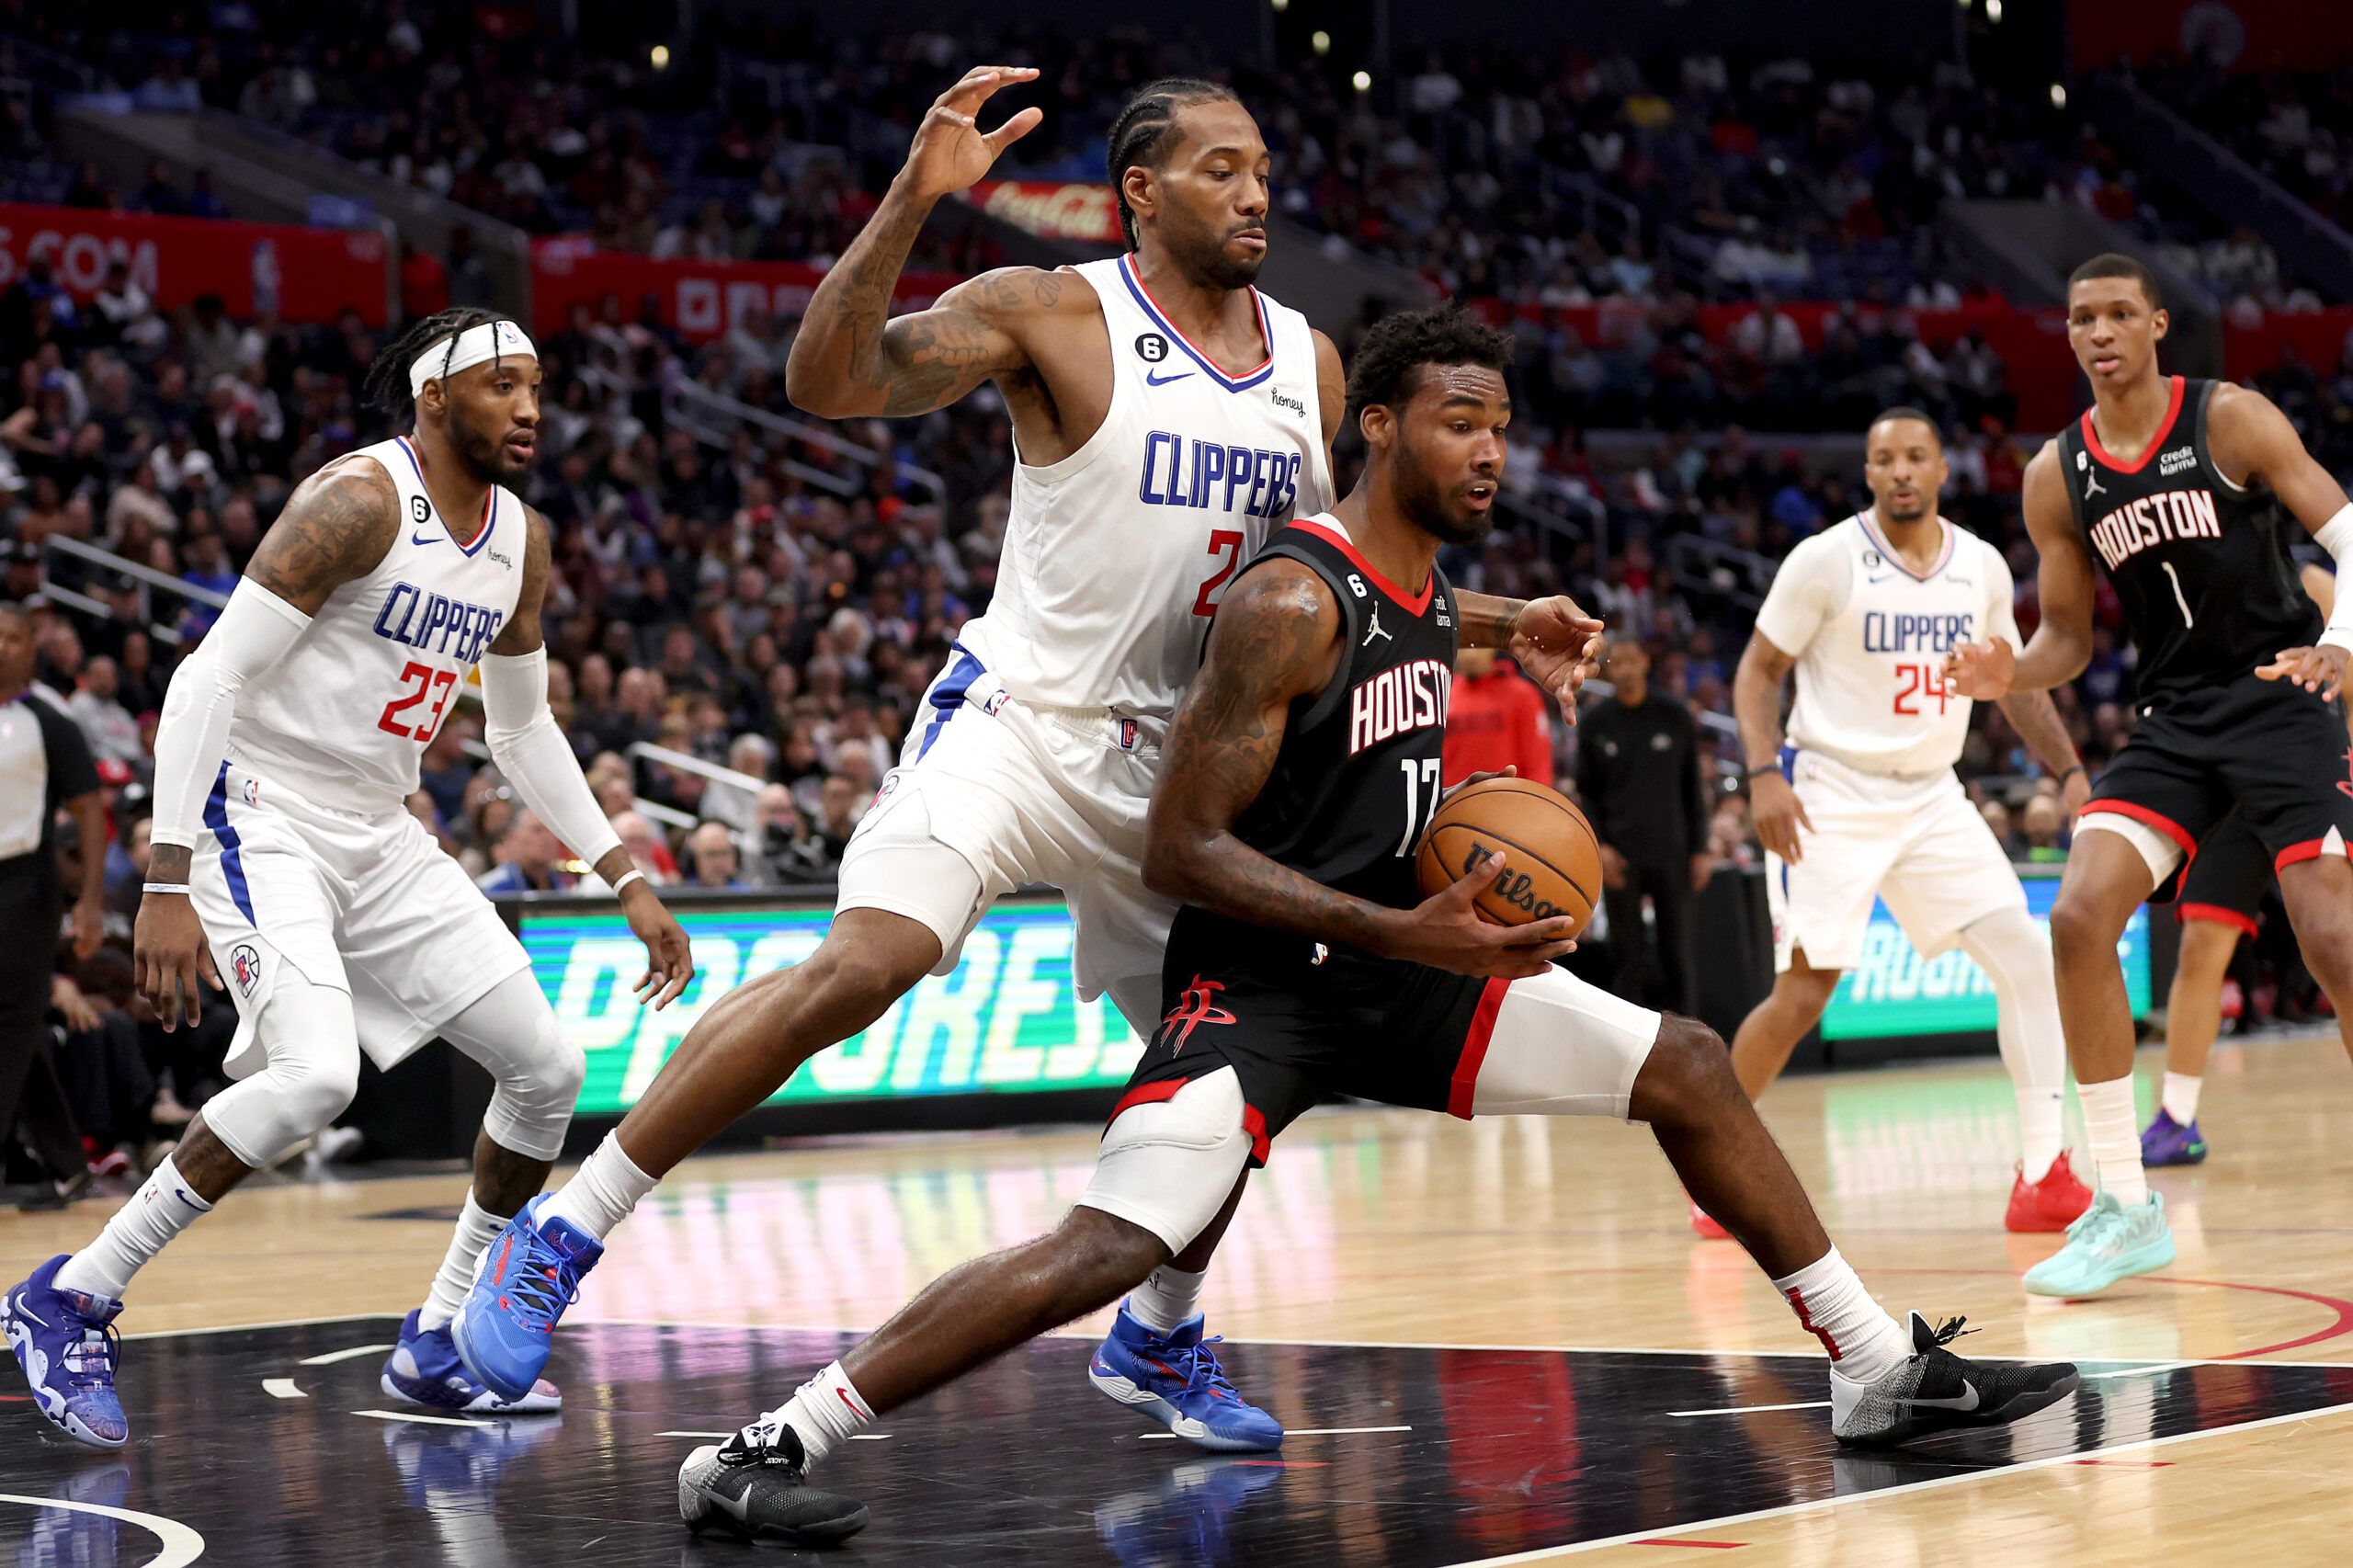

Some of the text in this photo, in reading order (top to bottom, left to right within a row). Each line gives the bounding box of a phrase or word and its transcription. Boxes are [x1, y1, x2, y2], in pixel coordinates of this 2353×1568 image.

[1142, 337, 1161, 360] 6
[1271, 387, 1305, 417] honey
[1139, 430, 1302, 518] CLIPPERS
[2076, 450, 2087, 471] 6
[2160, 456, 2197, 477] karma
[2090, 490, 2222, 572] HOUSTON
[487, 545, 512, 570] honey
[1192, 529, 1244, 617] 2
[1347, 574, 1368, 598] 6
[2161, 561, 2193, 629] 1
[373, 581, 503, 665] CLIPPERS
[1864, 611, 1972, 653] CLIPPERS
[378, 661, 457, 743] 23
[1893, 664, 1946, 715] 24
[1395, 757, 1440, 858] 17
